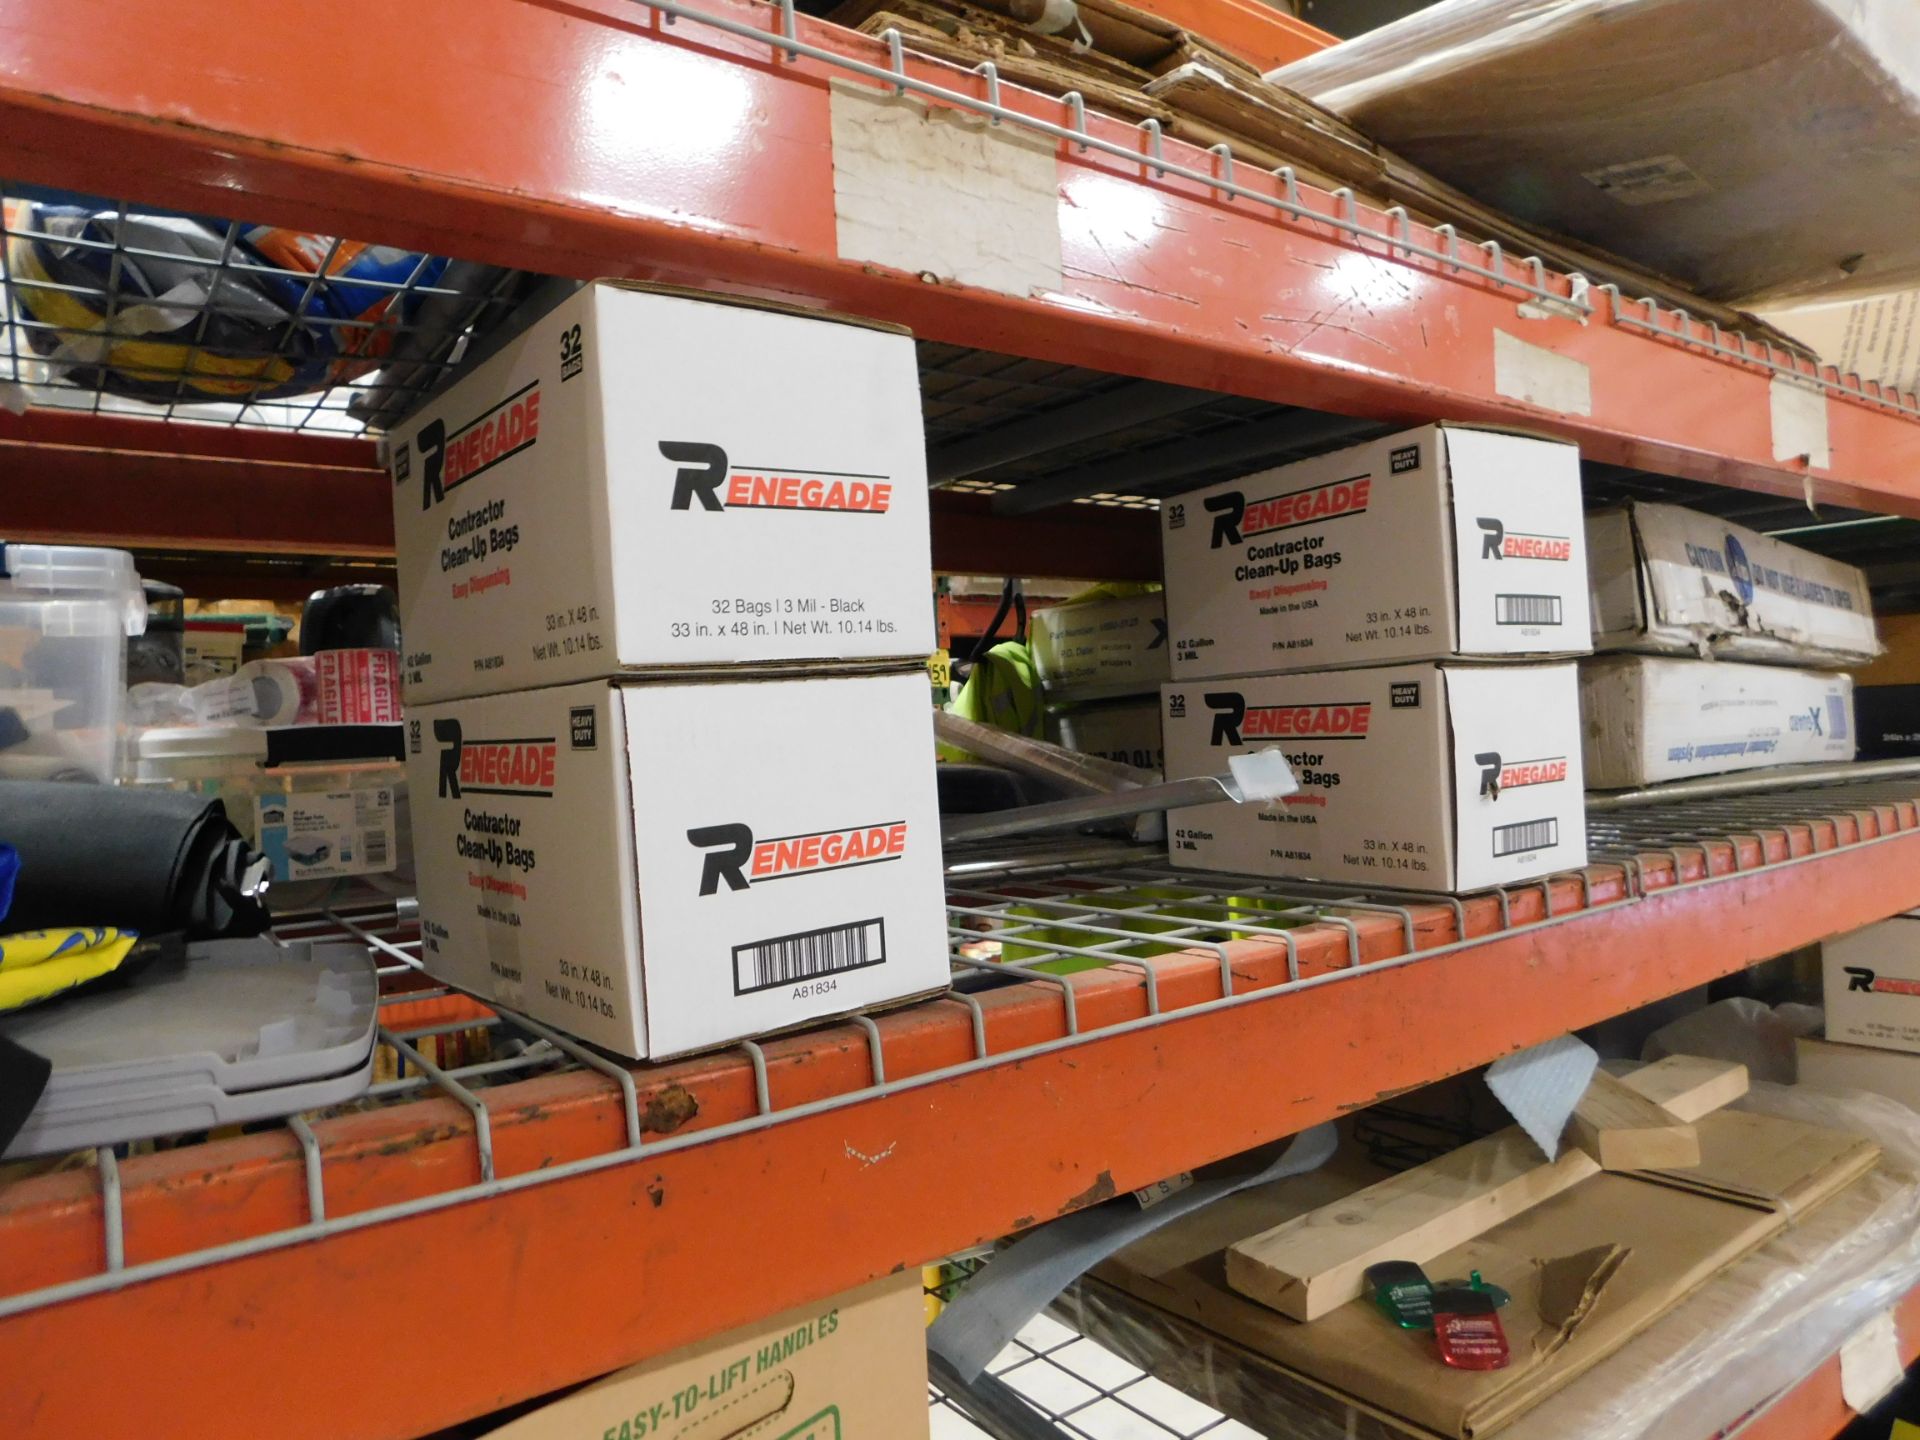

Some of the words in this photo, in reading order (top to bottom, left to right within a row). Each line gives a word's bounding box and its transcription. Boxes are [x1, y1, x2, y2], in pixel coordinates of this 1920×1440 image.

[561, 324, 581, 360] 32
[417, 391, 540, 511] RENEGADE
[1395, 459, 1415, 469] DUTY
[658, 440, 892, 512] RENEGADE
[449, 500, 504, 540] Contractor
[1169, 505, 1184, 520] 32
[1204, 479, 1371, 549] RENEGADE
[441, 535, 487, 572] Clean-Up
[491, 525, 519, 552] Bags
[1247, 536, 1324, 561] Contractor
[1476, 517, 1571, 560] RENEGADE
[1235, 558, 1299, 582] Clean-Up
[1304, 551, 1341, 571] Bags
[1249, 589, 1271, 601] Easy
[1274, 580, 1327, 597] Dispensing
[712, 600, 730, 614] 32
[736, 599, 772, 616] Bags
[784, 599, 792, 612] 3
[798, 599, 816, 612] Mil
[830, 599, 865, 612] Black
[1259, 606, 1278, 615] Made
[1280, 605, 1287, 613] in
[1289, 603, 1300, 612] the
[1302, 600, 1318, 609] USA
[1366, 613, 1377, 623] 33
[1380, 611, 1391, 621] in.
[1394, 609, 1402, 619] X
[1404, 608, 1416, 619] 48
[1419, 607, 1430, 617] in.
[546, 615, 556, 631] 33
[568, 609, 575, 626] X
[577, 606, 587, 623] 48
[589, 606, 599, 621] in.
[671, 622, 690, 637] 33
[695, 622, 712, 637] in.
[718, 626, 725, 636] x
[731, 622, 749, 636] 48
[753, 621, 769, 635] in.
[783, 621, 807, 635] Net
[810, 621, 832, 634] Wt.
[838, 620, 872, 633] 10.14
[876, 619, 897, 633] lbs.
[1177, 640, 1187, 649] 42
[1189, 638, 1214, 648] Gallon
[1346, 632, 1362, 642] Net
[1365, 630, 1379, 640] Wt.
[1384, 626, 1411, 639] 10.14
[1413, 624, 1432, 635] lbs.
[533, 644, 546, 662] Net
[549, 642, 560, 657] Wt.
[563, 635, 585, 655] 10.14
[587, 633, 603, 650] lbs.
[1178, 653, 1182, 661] 3
[1185, 651, 1199, 660] MIL
[323, 655, 338, 724] FRAGILE
[372, 653, 389, 722] FRAGILE
[1392, 687, 1416, 695] HEAVY
[1170, 695, 1185, 708] 32
[572, 715, 593, 727] HEAVY
[1204, 692, 1371, 745] RENEGADE
[410, 720, 421, 739] 32
[574, 728, 591, 741] DUTY
[434, 718, 556, 799] RENEGADE
[1303, 770, 1341, 788] Bags
[1474, 752, 1566, 795] RENEGADE
[464, 809, 521, 836] Contractor
[1258, 813, 1276, 822] Made
[1278, 814, 1285, 822] in
[1287, 814, 1298, 823] the
[1300, 815, 1317, 824] USA
[1176, 830, 1185, 838] 42
[1188, 830, 1213, 840] Gallon
[1176, 841, 1181, 849] 3
[1183, 841, 1197, 850] MIL
[457, 834, 503, 867] Clean-Up
[506, 841, 535, 872] Bags
[1271, 849, 1283, 859] P/N
[1364, 840, 1375, 850] 33
[1378, 841, 1389, 850] in.
[1392, 841, 1399, 851] X
[1402, 842, 1413, 853] 48
[1417, 843, 1428, 854] in.
[687, 822, 907, 896] RENEGADE
[1343, 854, 1360, 865] Net
[1362, 856, 1377, 867] Wt.
[1382, 857, 1409, 869] 10.14
[1411, 860, 1429, 872] lbs.
[477, 905, 491, 919] Made
[499, 911, 507, 923] the
[508, 914, 521, 927] USA
[559, 959, 569, 977] 33
[582, 964, 588, 981] X
[590, 969, 600, 986] 48
[603, 973, 613, 990] in.
[545, 980, 558, 997] Net
[560, 985, 572, 1004] Wt.
[575, 991, 598, 1010] 10.14
[600, 998, 616, 1019] lbs.
[793, 979, 837, 999] A81834
[603, 1356, 751, 1440] EASY-TO-LIFT
[757, 1309, 838, 1374] HANDLES
